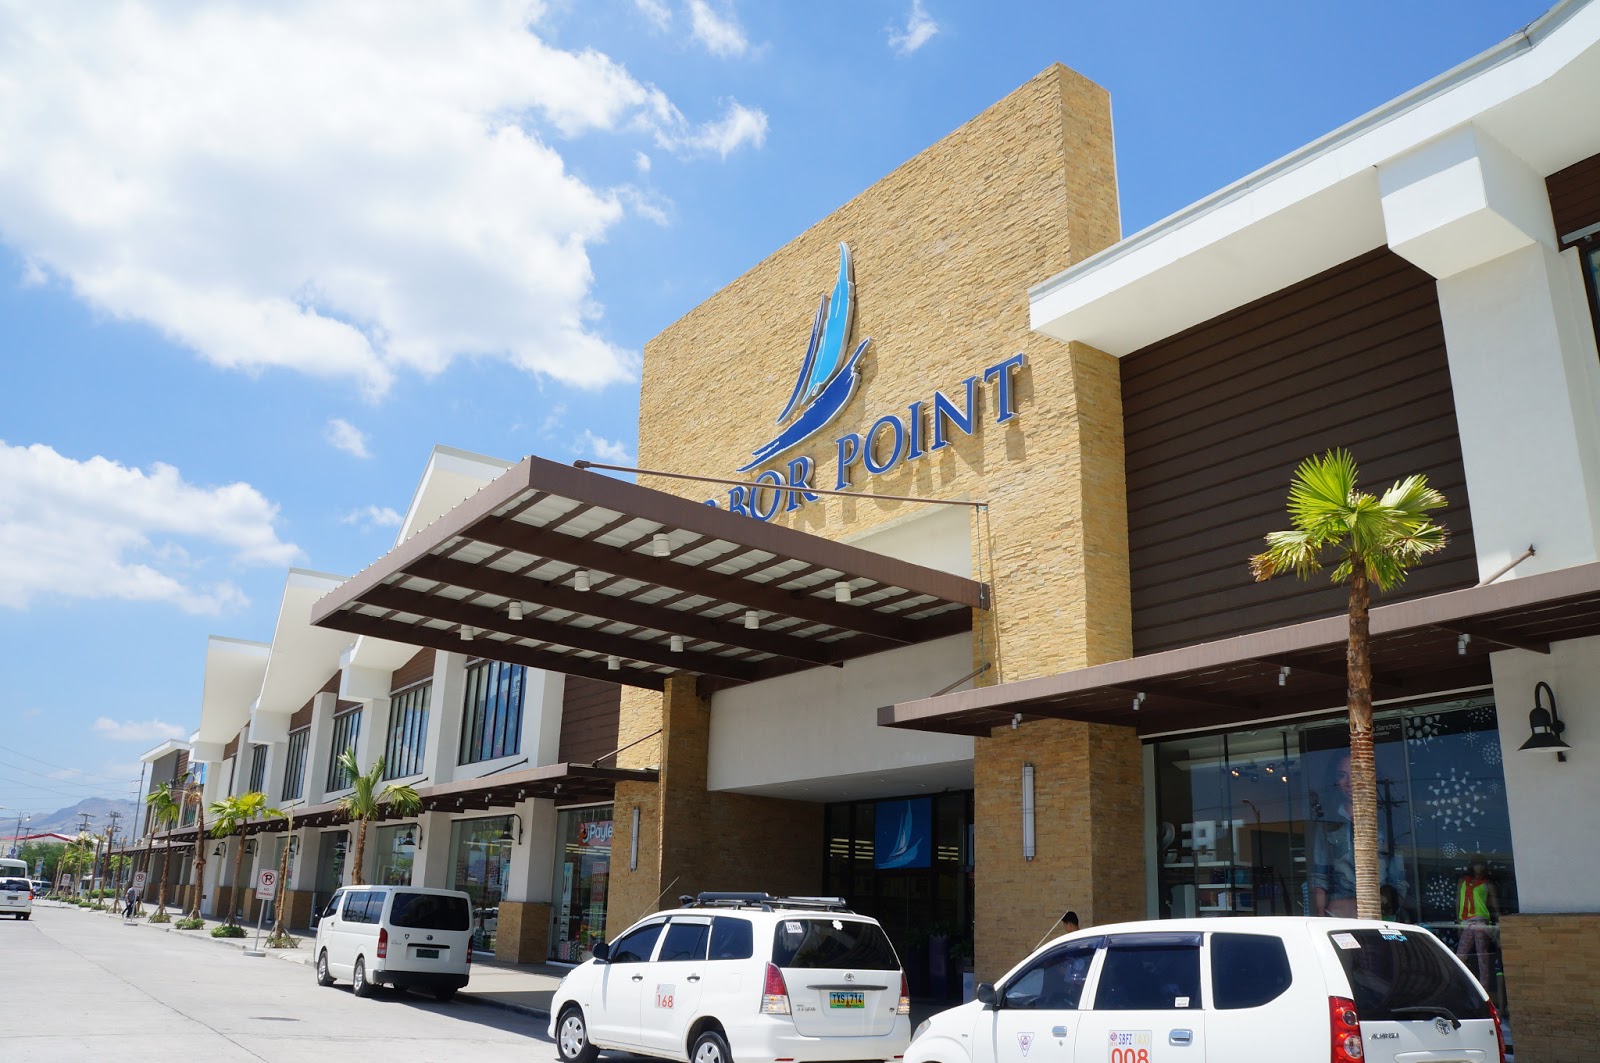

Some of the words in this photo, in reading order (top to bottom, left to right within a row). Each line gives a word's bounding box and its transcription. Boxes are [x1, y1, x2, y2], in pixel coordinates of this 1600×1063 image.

[704, 455, 820, 522] BOR
[834, 352, 1028, 491] POINT
[657, 994, 674, 1008] 168
[832, 994, 846, 1004] TXS
[849, 994, 863, 1004] 714
[1118, 1033, 1133, 1046] SBFZ
[1134, 1033, 1151, 1046] TAXI
[1111, 1047, 1150, 1063] 008
